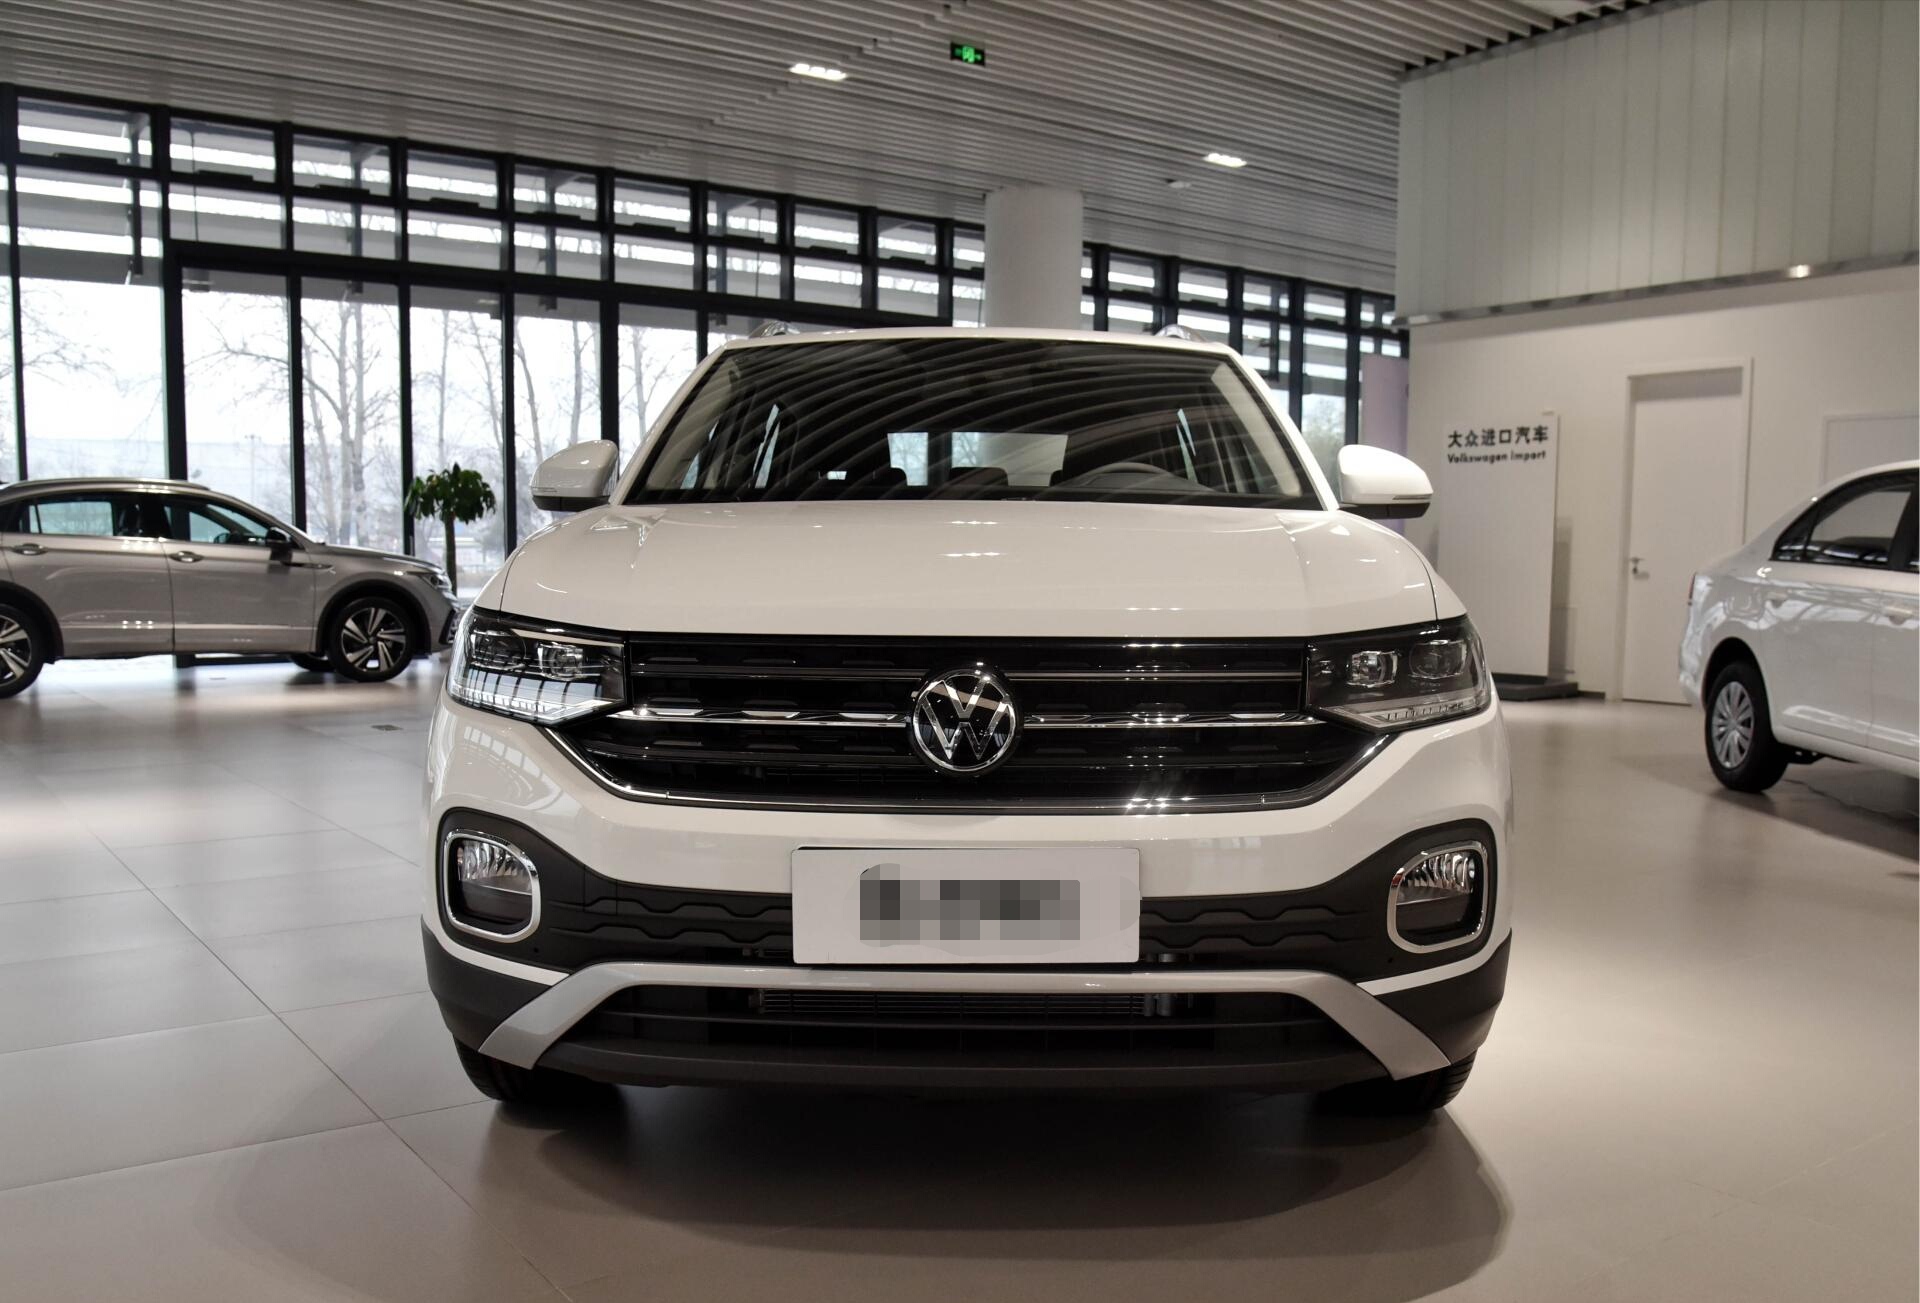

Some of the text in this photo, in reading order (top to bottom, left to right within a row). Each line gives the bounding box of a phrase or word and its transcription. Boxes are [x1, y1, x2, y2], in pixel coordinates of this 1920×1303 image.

[1448, 425, 1549, 448] 大众进口汽车
[1447, 452, 1508, 464] Volkswagen
[914, 675, 1015, 771] VW
